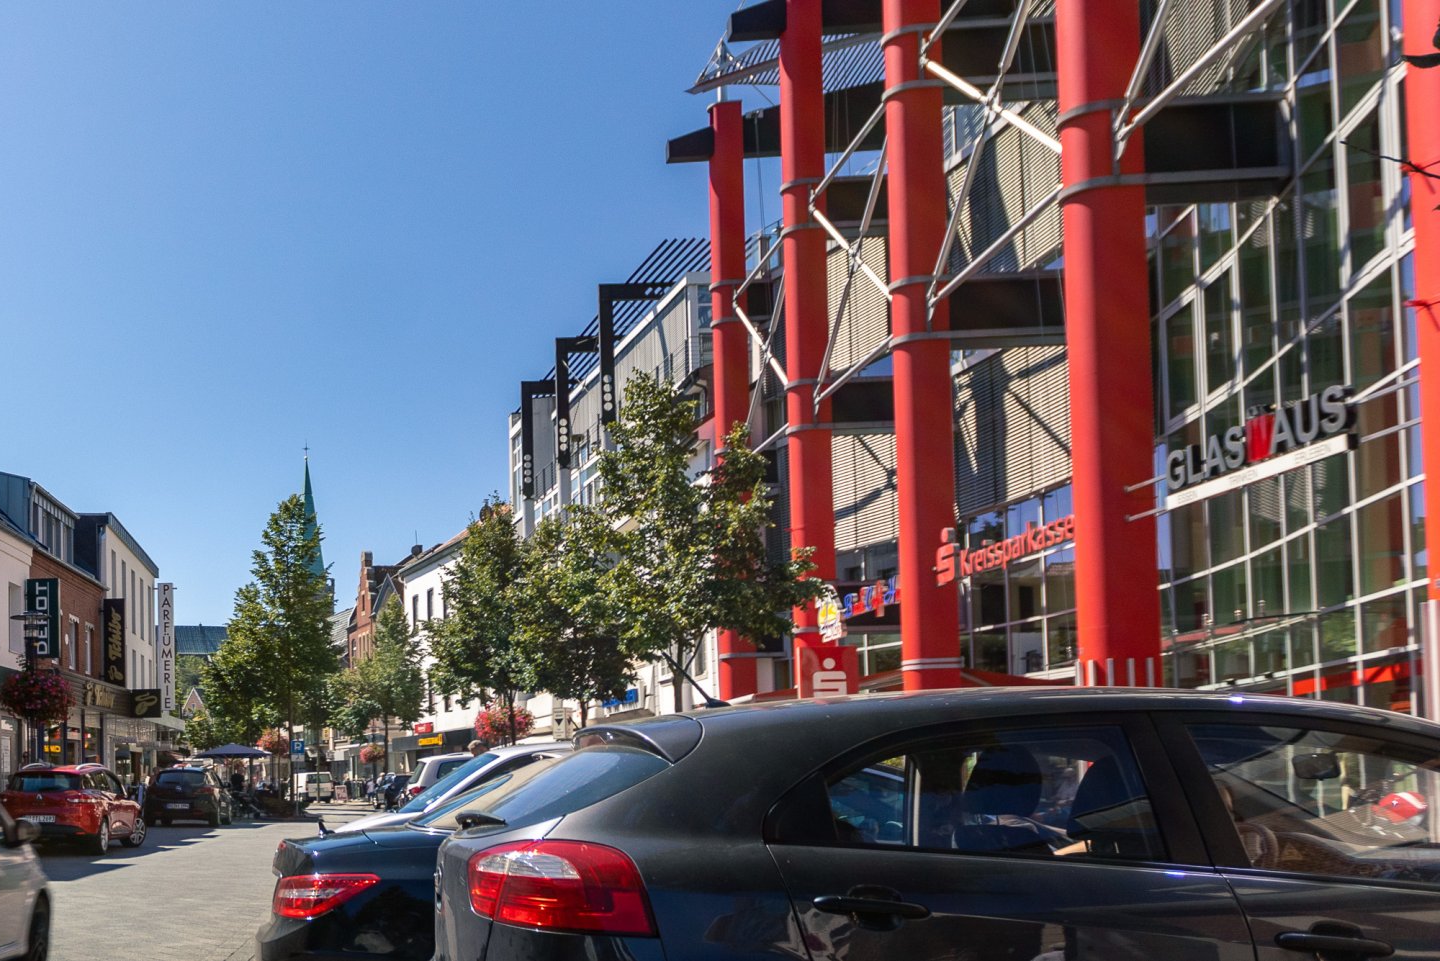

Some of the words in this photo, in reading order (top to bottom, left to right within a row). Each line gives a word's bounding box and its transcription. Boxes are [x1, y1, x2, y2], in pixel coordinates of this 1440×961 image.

[960, 514, 1075, 577] Kreissparkasse
[108, 606, 122, 661] Tchibo
[161, 584, 173, 709] PARFÜMERIE
